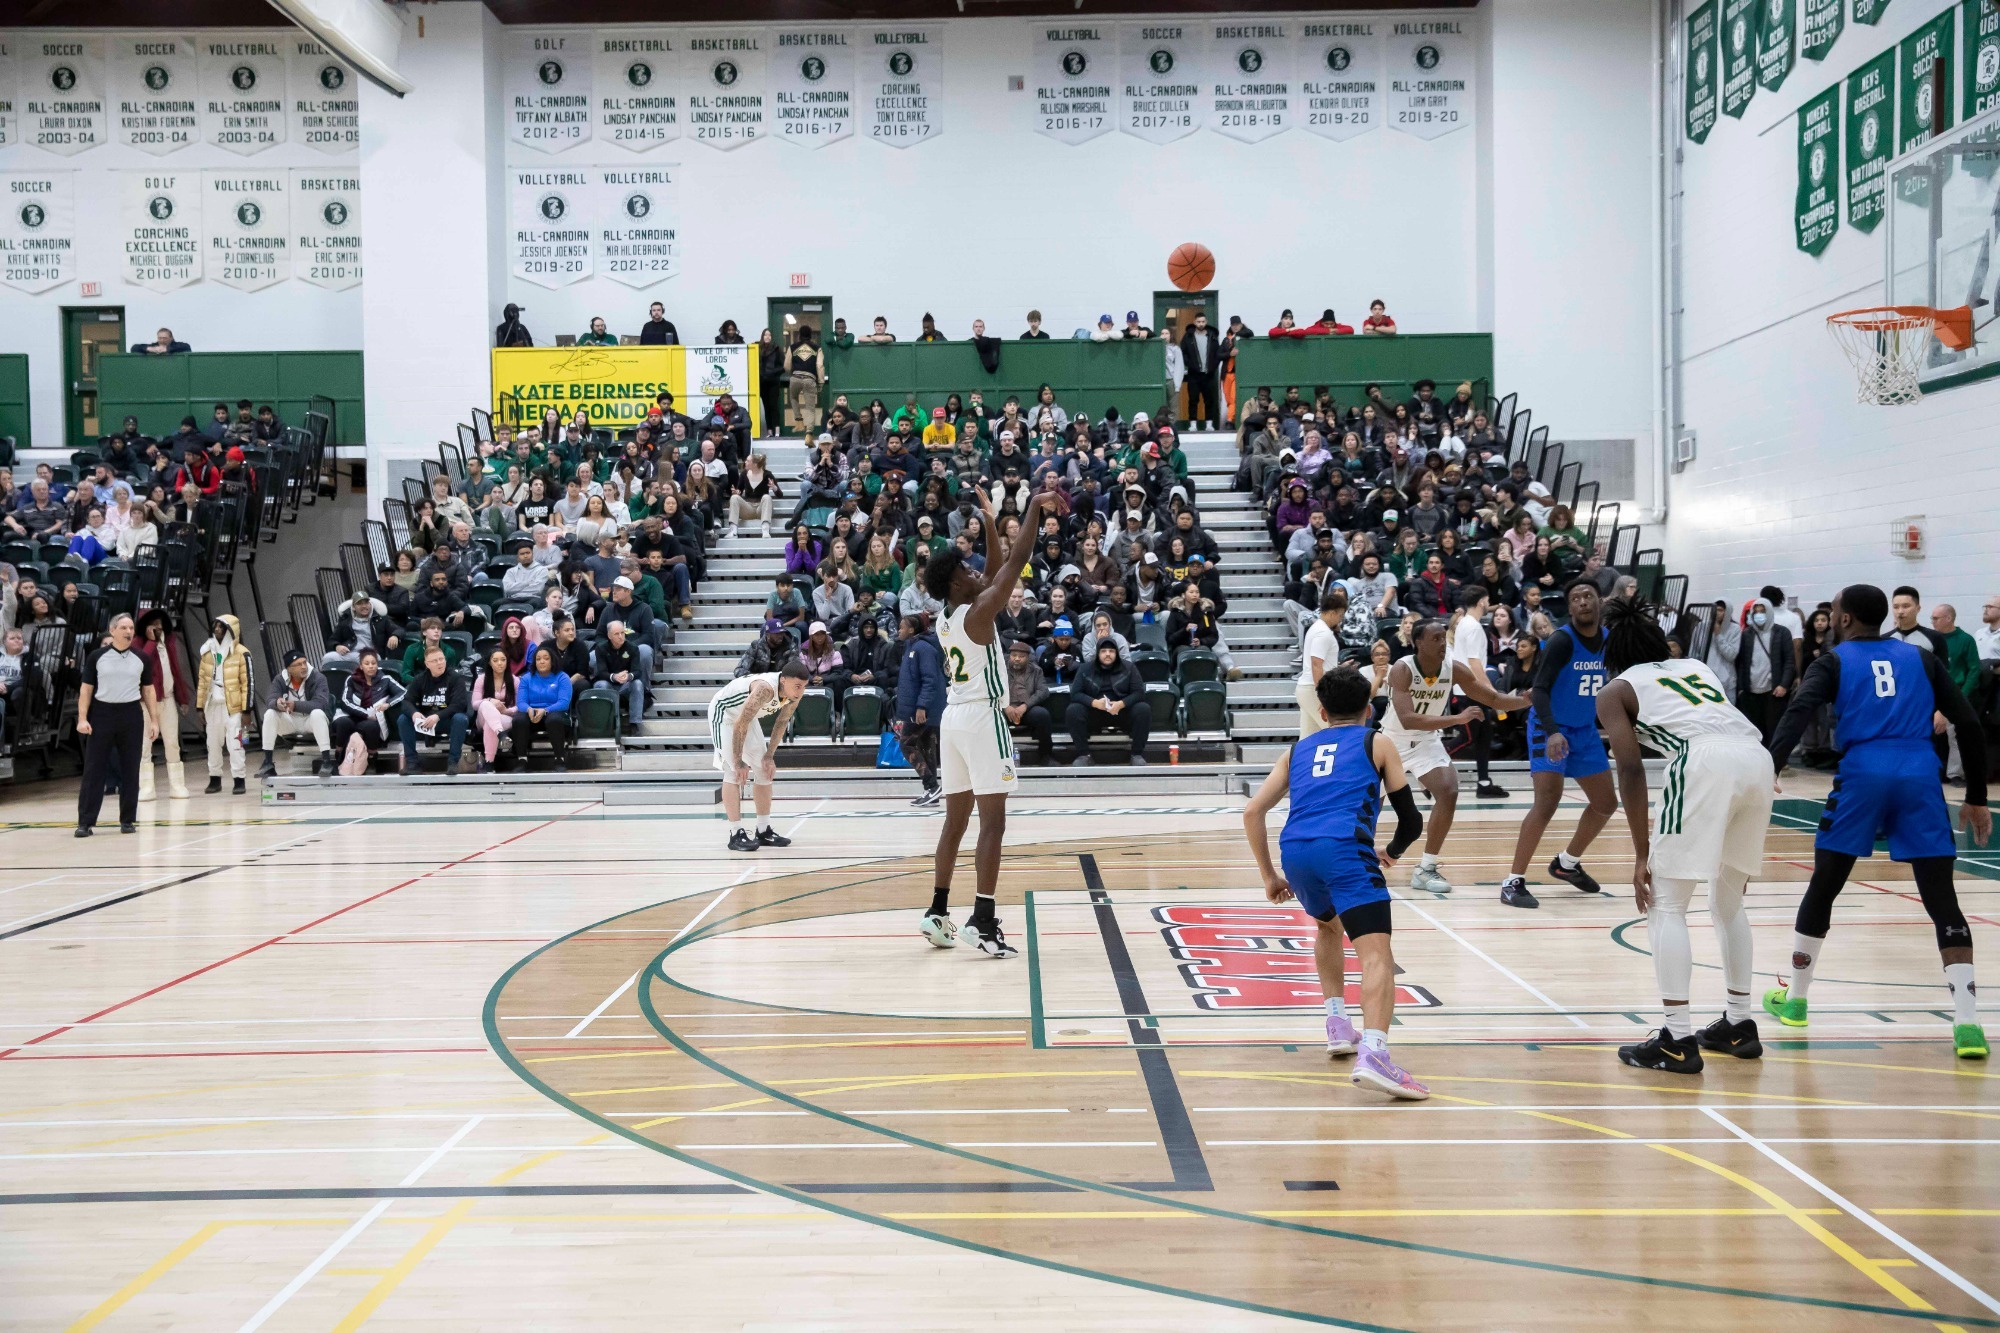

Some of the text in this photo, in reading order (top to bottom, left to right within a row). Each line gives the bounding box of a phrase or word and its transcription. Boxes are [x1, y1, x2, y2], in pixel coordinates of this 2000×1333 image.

[1806, 1, 1838, 31] AMPIONS
[1047, 28, 1100, 40] VOLLEYBALL
[1142, 27, 1182, 40] SOCCER
[1216, 26, 1285, 38] BASKETBALL
[1304, 24, 1373, 36] BASKETBALL
[1393, 22, 1462, 34] VOLLEYBALL
[534, 38, 565, 50] GOLF
[691, 38, 758, 50] BASKETBALL
[779, 34, 847, 46] BASKETBALL
[874, 32, 928, 44] VOLLEYBALL
[43, 44, 83, 56] SOCCER
[135, 43, 175, 55] SOCCER
[209, 44, 277, 55] VOLLEYBALL
[604, 40, 672, 52] BASKETBALL
[1916, 31, 1937, 58] MEN'S
[1392, 80, 1464, 92] ALL-CANADIAN
[1861, 68, 1880, 92] MEN'S
[882, 83, 920, 95] COACHING
[1038, 86, 1110, 99] ALL-CANADIAN
[1126, 85, 1198, 97] ALL-CANADIAN
[1215, 84, 1287, 96] ALL-CANADIAN
[1303, 82, 1375, 94] ALL-CANADIAN
[515, 96, 587, 107] ALL-CANADIAN
[603, 97, 675, 109] ALL-CANADIAN
[690, 96, 762, 108] ALL-CANADIAN
[777, 91, 849, 103] ALL-CANADIAN
[875, 97, 927, 109] EXCELLENCE
[1309, 97, 1369, 109] KENDRA OLIVER
[1408, 96, 1448, 108] LIAM GRAY
[1854, 84, 1886, 115] BASEBALL
[28, 102, 100, 113] ALL-CANADIAN
[121, 101, 195, 113] ALL-CANADIAN
[208, 101, 281, 113] ALL-CANADIAN
[1040, 101, 1107, 114] ALLISON MARSHALL
[1133, 100, 1189, 112] BRUCE CULLEN
[1215, 99, 1244, 111] BRANDON
[516, 111, 587, 123] TIFFANY ALBATH
[603, 112, 676, 125] LINDSAY PANCHAN
[691, 111, 762, 123] LINDSAY PANCHAN
[777, 107, 849, 119] LINDSAY PANCHAN
[877, 111, 926, 122] TONY CLARKE
[1309, 112, 1369, 124] 2019-20
[1399, 110, 1458, 123] 2019-20
[1806, 101, 1830, 127] WOMEN'S
[39, 116, 92, 128] LAURA DIXON
[121, 116, 196, 128] KRISTINA FOREMAN
[223, 116, 268, 128] ERIN SMITH
[303, 116, 323, 127] ADAM
[1046, 117, 1103, 129] 2016-17
[1132, 115, 1191, 127] 2017-18
[1222, 114, 1281, 127] 2018-19
[523, 126, 580, 138] 2012-13
[615, 128, 665, 140] 2014-15
[697, 127, 754, 138] 2015-16
[785, 122, 842, 134] 2016-17
[873, 124, 930, 136] 2016-17
[1803, 117, 1832, 146] SOFTBALL
[37, 132, 94, 144] 2003-04
[131, 132, 187, 143] 2003-04
[218, 131, 275, 143] 2003-04
[1851, 154, 1885, 186] NATIONAL
[145, 177, 176, 189] GOLF
[519, 174, 586, 185] VOLLEYBALL
[604, 172, 672, 184] VOLLEYBALL
[11, 181, 52, 193] SOCCER
[214, 180, 282, 191] VOLLEYBALL
[1809, 187, 1826, 208] OCAA
[1800, 200, 1835, 230] CHAMPIONS
[134, 228, 189, 239] COACHING
[517, 231, 589, 242] ALL-CANADIAN
[603, 229, 675, 241] ALL-CANADIAN
[1802, 218, 1834, 246] 2021-22
[0, 239, 71, 251] ALL-CANADIAN
[125, 241, 197, 253] EXCELLENCE
[213, 237, 286, 249] ALL-CANADIAN
[300, 236, 362, 248] ALL-CANADI
[519, 245, 587, 257] JESSICA JOENSEN
[606, 244, 672, 256] MIA HILDEBRANDT
[7, 254, 61, 266] KATIE WATTS
[129, 255, 194, 266] MICHAEL DUGGAN
[225, 252, 275, 264] PJ CORNELIUS
[315, 252, 358, 263] ERIC SMITH
[524, 260, 582, 272] 2019-20
[610, 259, 669, 271] 2021-22
[5, 268, 59, 280] 2009-10
[136, 268, 189, 279] 2010-11
[223, 267, 276, 279] 2010-11
[310, 267, 362, 278] 2010-11
[791, 273, 806, 285] EXIT
[81, 282, 96, 294] EXIT
[694, 347, 713, 355] VOICE
[715, 347, 723, 355] OF
[512, 382, 669, 400] KATE BEIRNESS
[508, 404, 572, 420] MEDA
[525, 506, 548, 514] LORDS
[1870, 660, 1896, 697] 8
[1578, 674, 1603, 696] 22
[1656, 673, 1725, 706] 15
[1414, 702, 1430, 714] 11
[1312, 743, 1338, 777] 5
